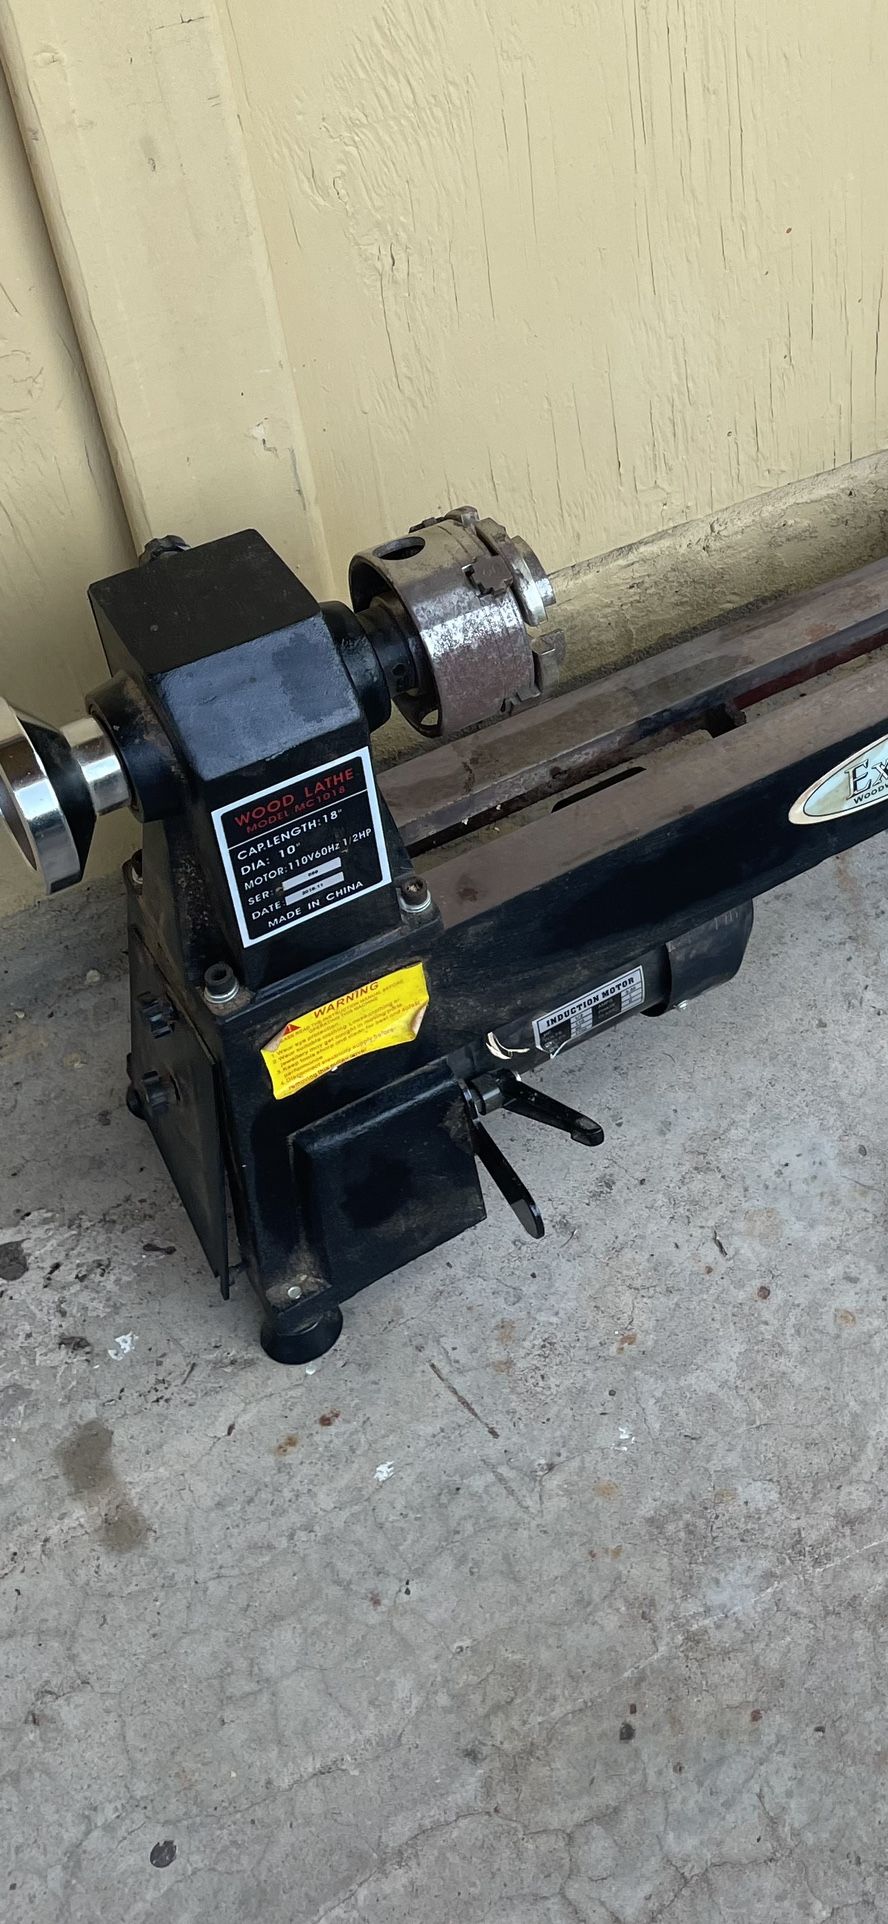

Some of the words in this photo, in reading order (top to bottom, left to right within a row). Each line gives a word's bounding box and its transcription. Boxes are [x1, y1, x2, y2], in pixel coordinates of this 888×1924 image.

[235, 794, 294, 826] WOOD
[304, 768, 354, 797] LATHE
[246, 811, 289, 833] MODEL
[295, 786, 345, 812] MC1018
[853, 783, 888, 804] WOOD
[343, 829, 372, 847] 1/2HP
[241, 857, 270, 876] DIA:
[279, 843, 301, 858] 10"
[248, 889, 274, 905] SER:
[252, 900, 286, 920] DATE:
[268, 908, 301, 928] MADE
[308, 900, 320, 910] IN
[326, 881, 363, 901] CHINA
[313, 981, 379, 1018] WARNING
[546, 995, 599, 1027] INDUCTION
[602, 977, 634, 998] MOTOR
